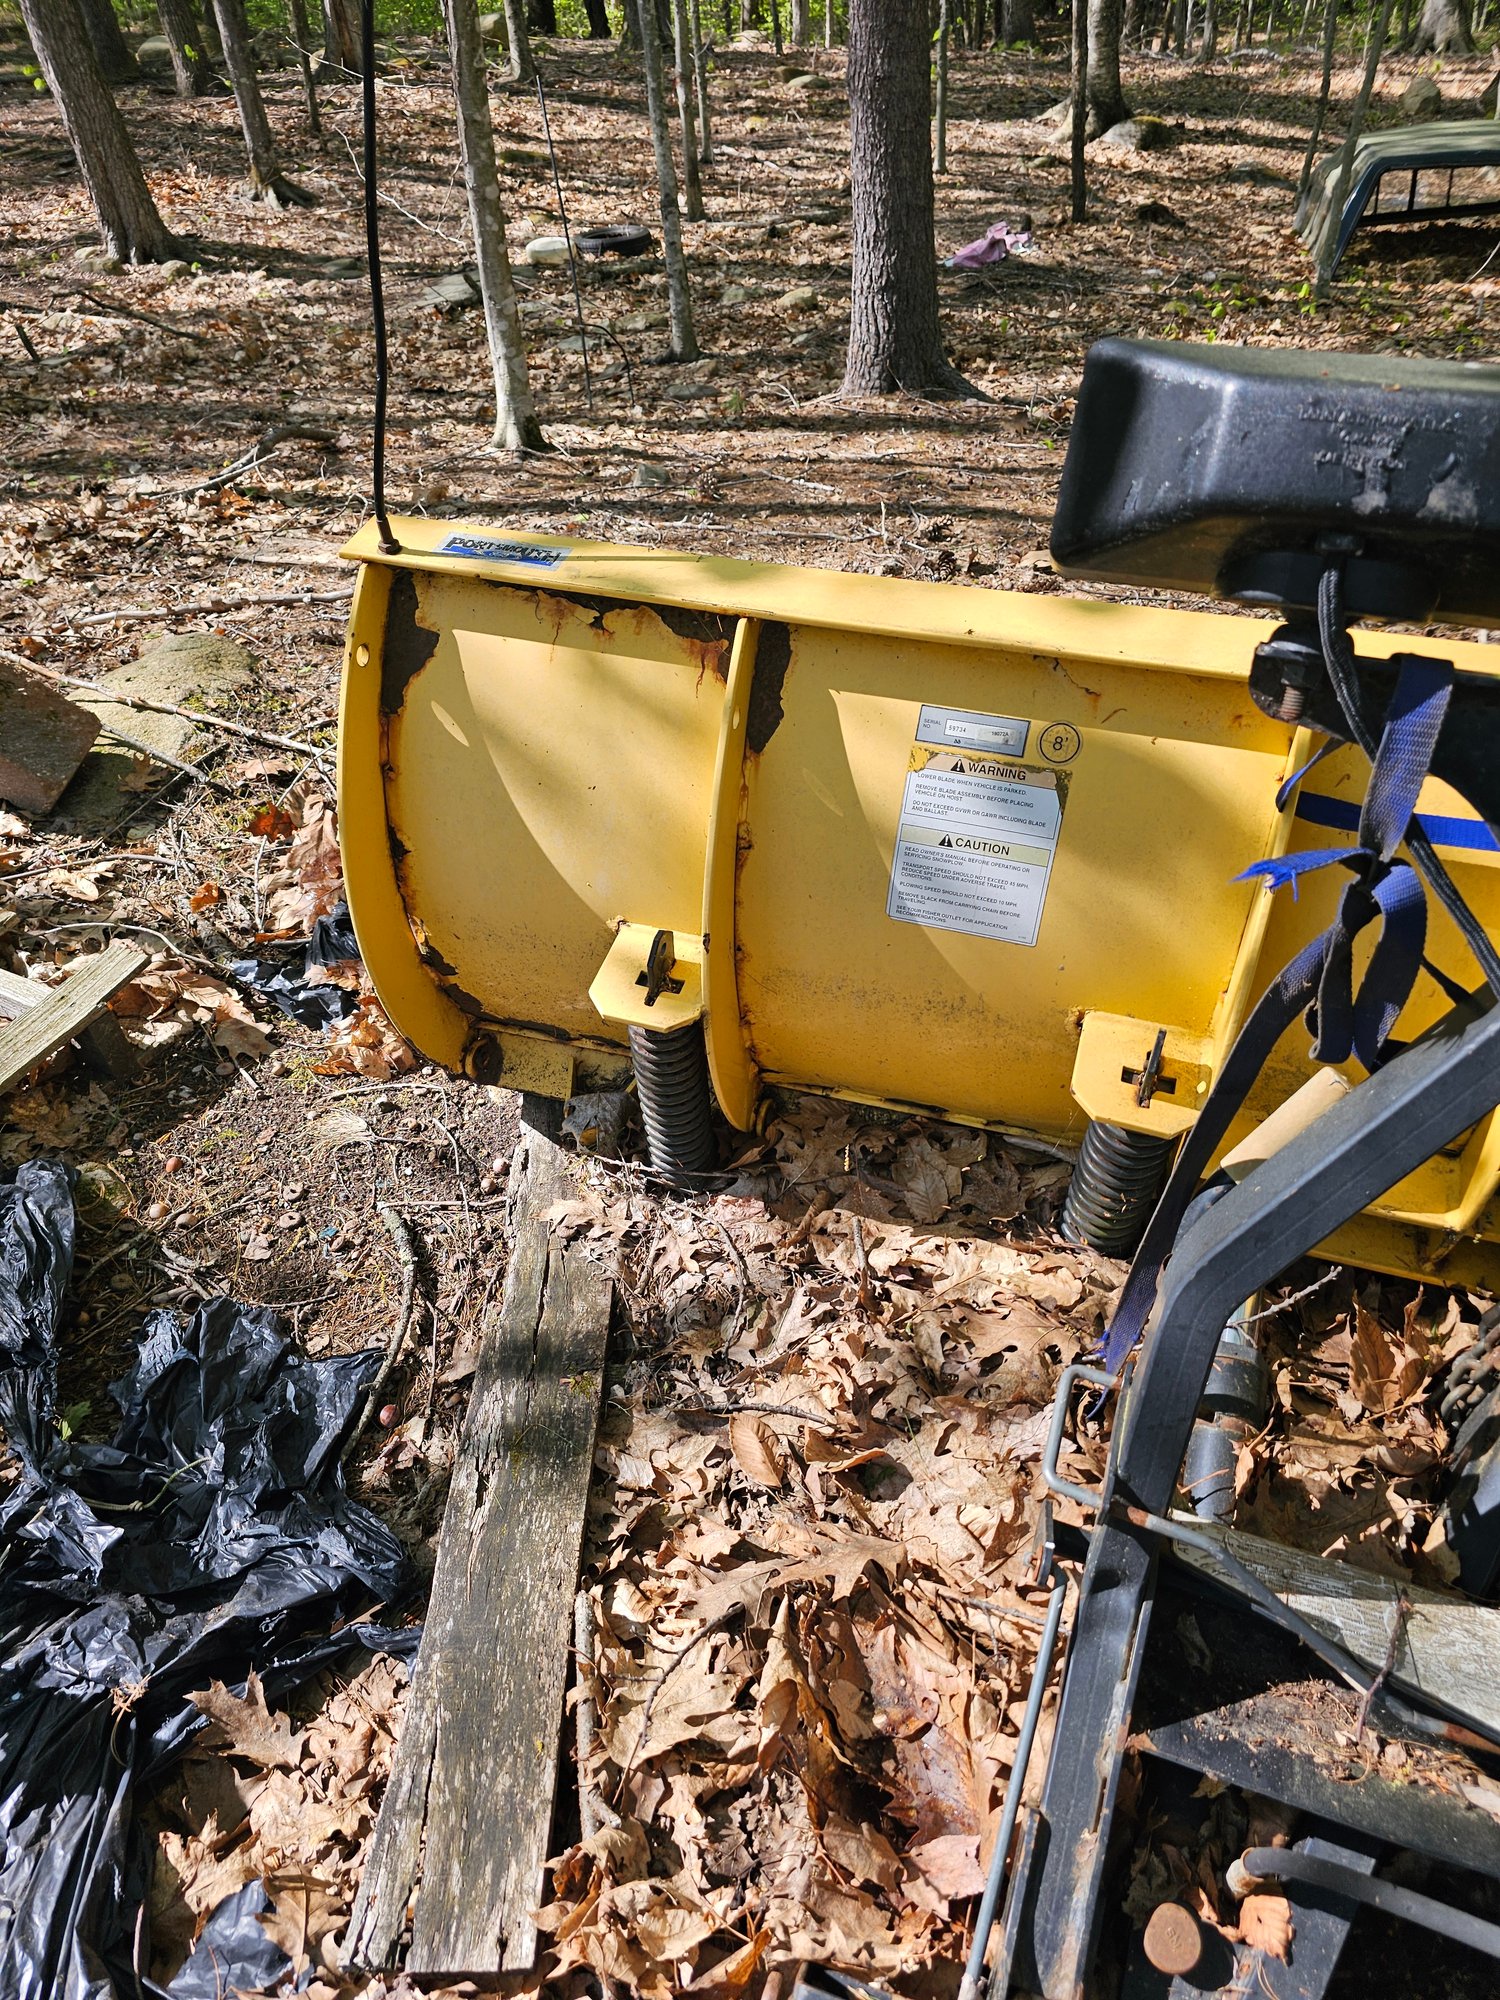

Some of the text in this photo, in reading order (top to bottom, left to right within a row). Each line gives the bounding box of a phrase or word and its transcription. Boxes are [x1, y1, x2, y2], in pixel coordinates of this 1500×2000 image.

[444, 536, 562, 563] PORTSMOUTH
[924, 718, 942, 726] SERIAL
[948, 725, 967, 734] 59734
[967, 762, 1027, 781] WARNING
[915, 789, 937, 797] VEHICLE
[917, 772, 937, 780] LOWER
[974, 782, 996, 790] VEHICLE
[1004, 787, 1028, 796] PARKED.
[915, 783, 1034, 808] REMOVE BLADE ASSEMBLY BEFORE PLACING
[933, 804, 954, 812] EXCEED
[954, 807, 972, 815] GVWR
[998, 815, 1028, 824] INCLUDING
[1028, 820, 1047, 828] BLADE
[904, 852, 932, 861] SERVICING
[955, 837, 1010, 856] CAUTION
[945, 854, 967, 862] MANUAL
[967, 858, 990, 866] BEFORE
[990, 862, 1021, 872] OPERATING
[901, 867, 923, 875] REDUCE
[942, 874, 960, 882] UNDER
[960, 878, 986, 886] ADVERSE
[986, 882, 1007, 890] TRAVEL
[903, 862, 933, 871] TRANSPORT
[934, 867, 952, 875] SPEED
[952, 871, 975, 879] SHOULD
[987, 877, 1009, 886] EXCEED
[899, 881, 923, 890] PLOWING
[941, 889, 964, 898] SHOULD
[976, 896, 998, 904] EXCEED
[898, 891, 920, 899] REMOVE
[920, 895, 938, 903] SLACK
[954, 901, 982, 911] CARRYING
[999, 910, 1021, 919] BEFORE
[941, 913, 962, 921] OUTLET
[974, 920, 1009, 931] APPLICATION
